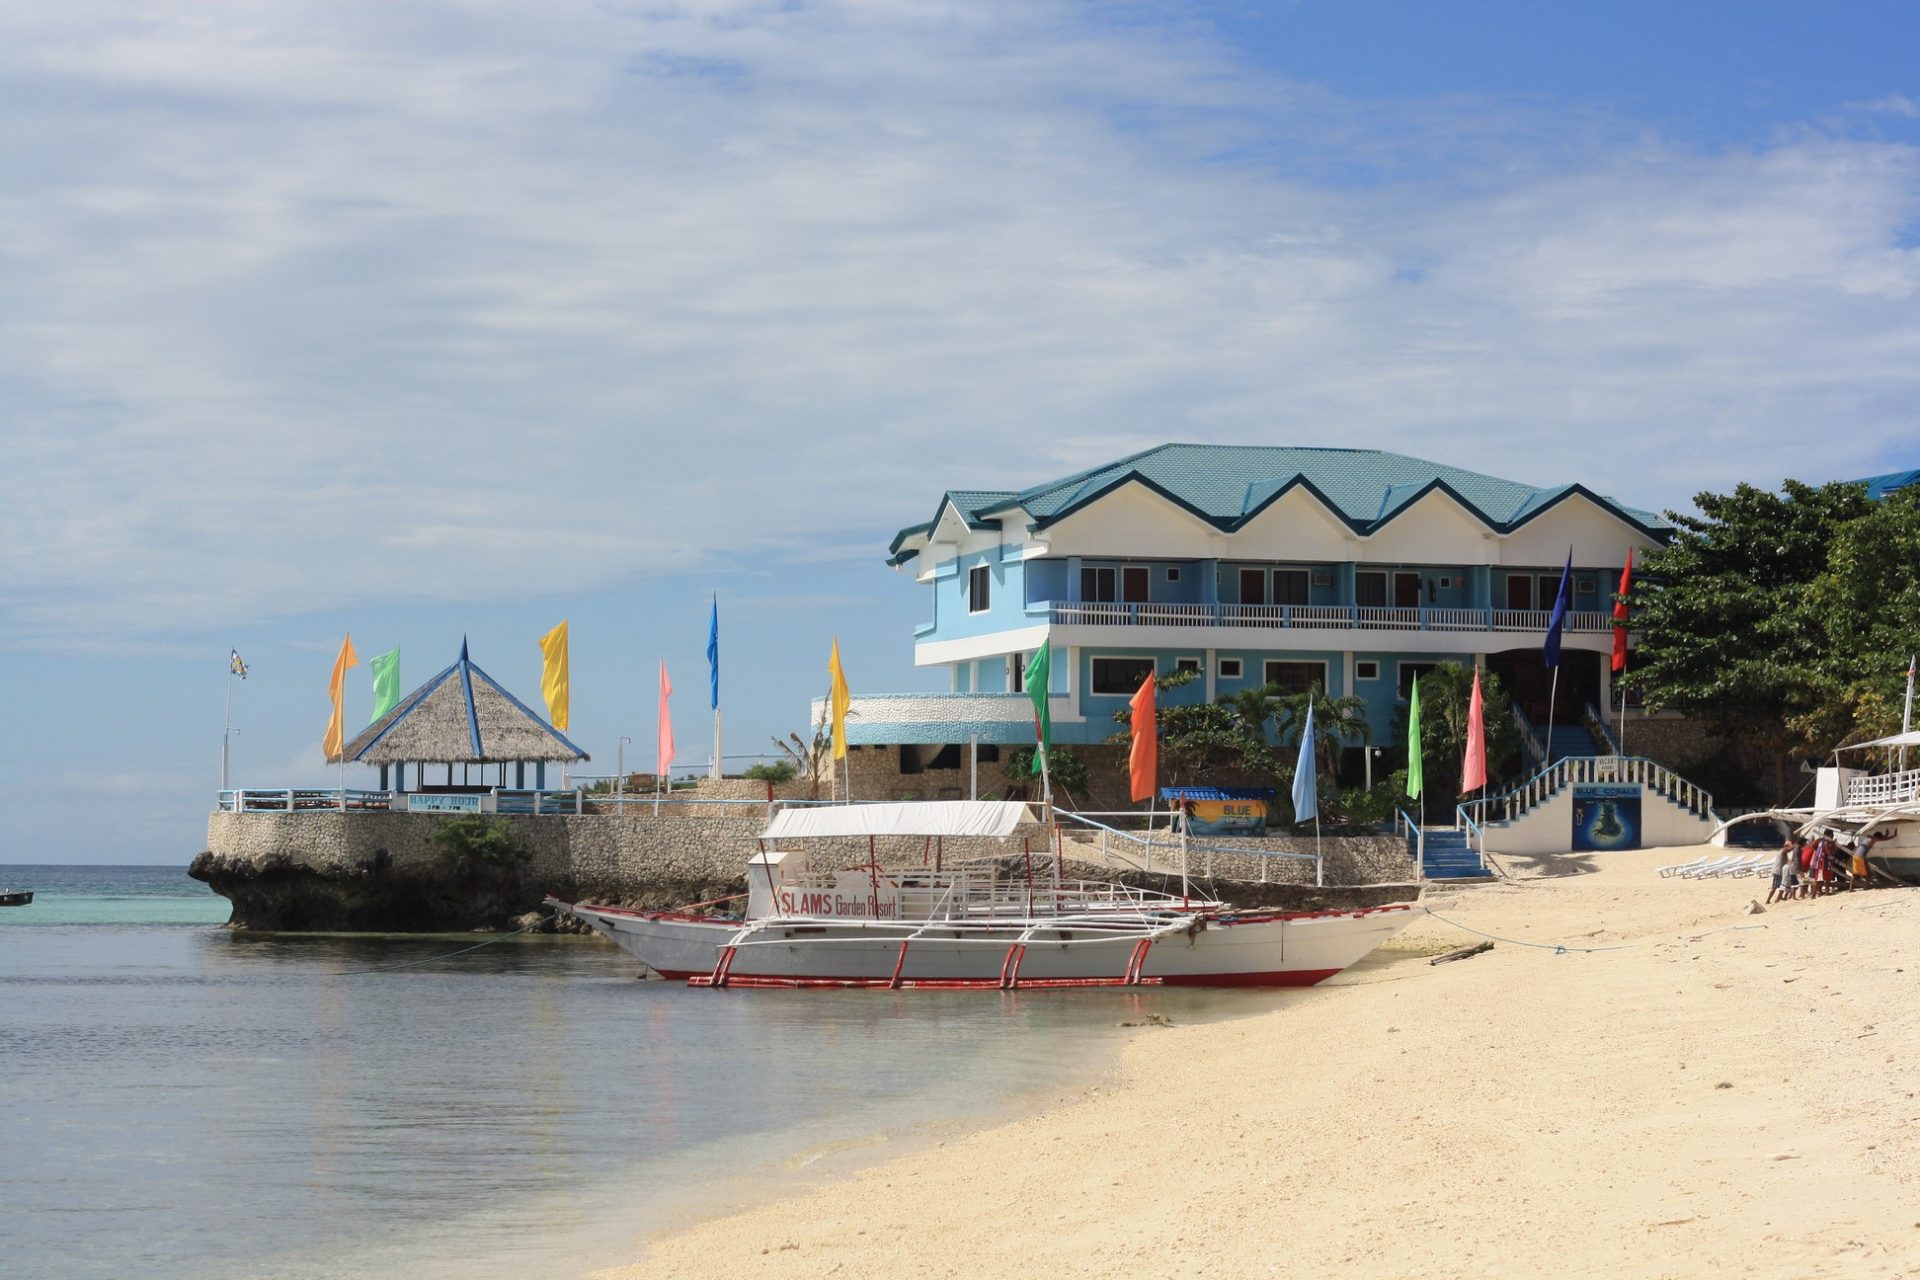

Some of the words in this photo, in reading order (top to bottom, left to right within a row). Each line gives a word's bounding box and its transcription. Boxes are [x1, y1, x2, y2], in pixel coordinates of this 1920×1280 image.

[410, 795, 446, 805] HAPPY
[451, 796, 479, 806] HOUR
[1223, 804, 1252, 816] BLUE
[781, 893, 832, 915] SLAMS
[835, 894, 866, 916] Garden
[867, 895, 897, 917] Rsort
